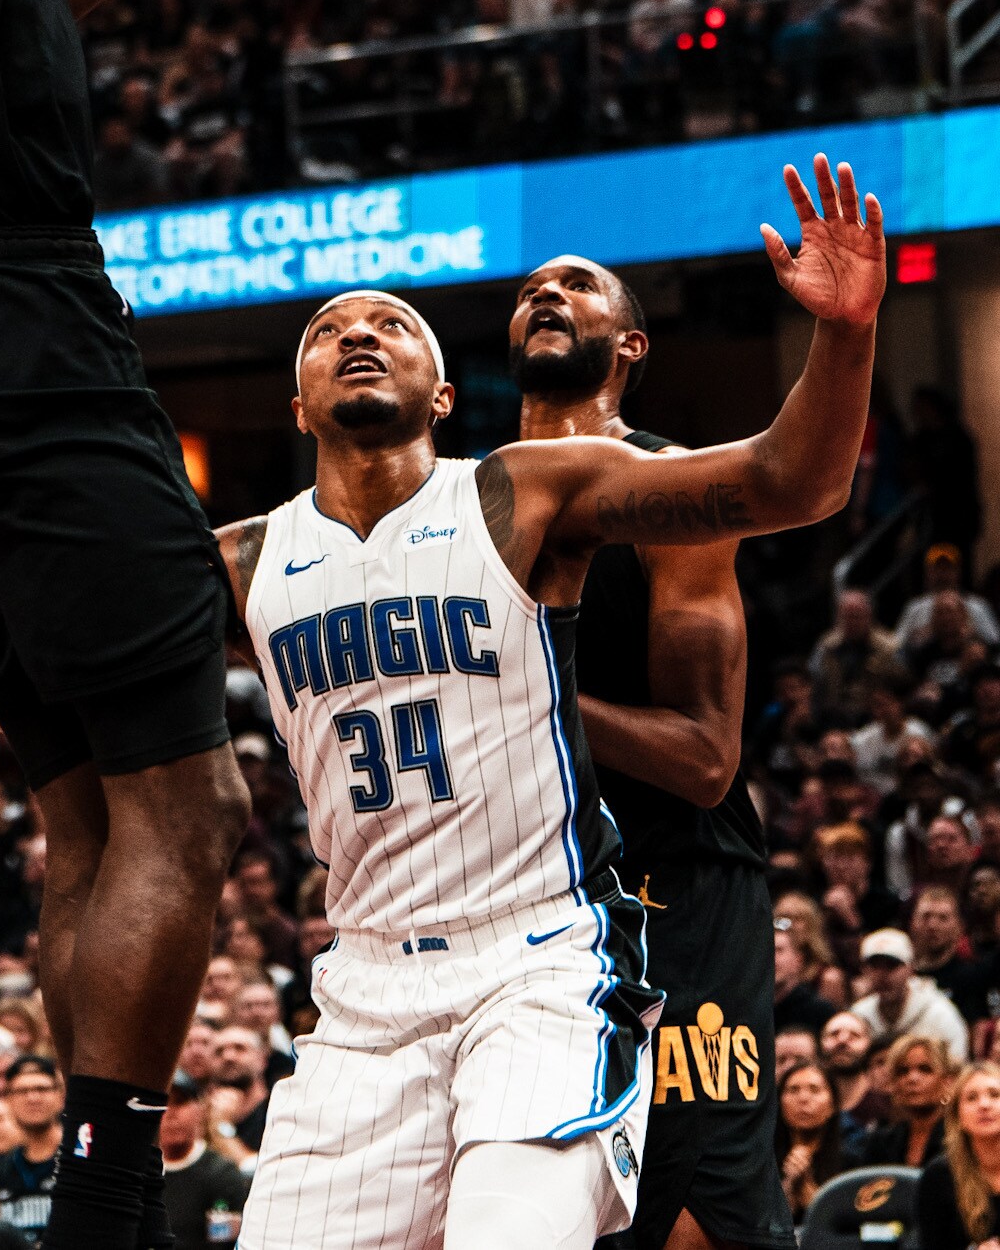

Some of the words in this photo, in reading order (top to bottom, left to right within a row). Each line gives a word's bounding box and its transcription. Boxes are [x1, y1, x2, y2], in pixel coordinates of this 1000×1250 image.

[240, 187, 402, 248] COLLEGE
[303, 225, 484, 284] MEDICINE
[403, 525, 457, 545] Disney
[269, 595, 500, 712] MAGIC
[332, 698, 454, 813] 34
[653, 1023, 760, 1105] AVS
